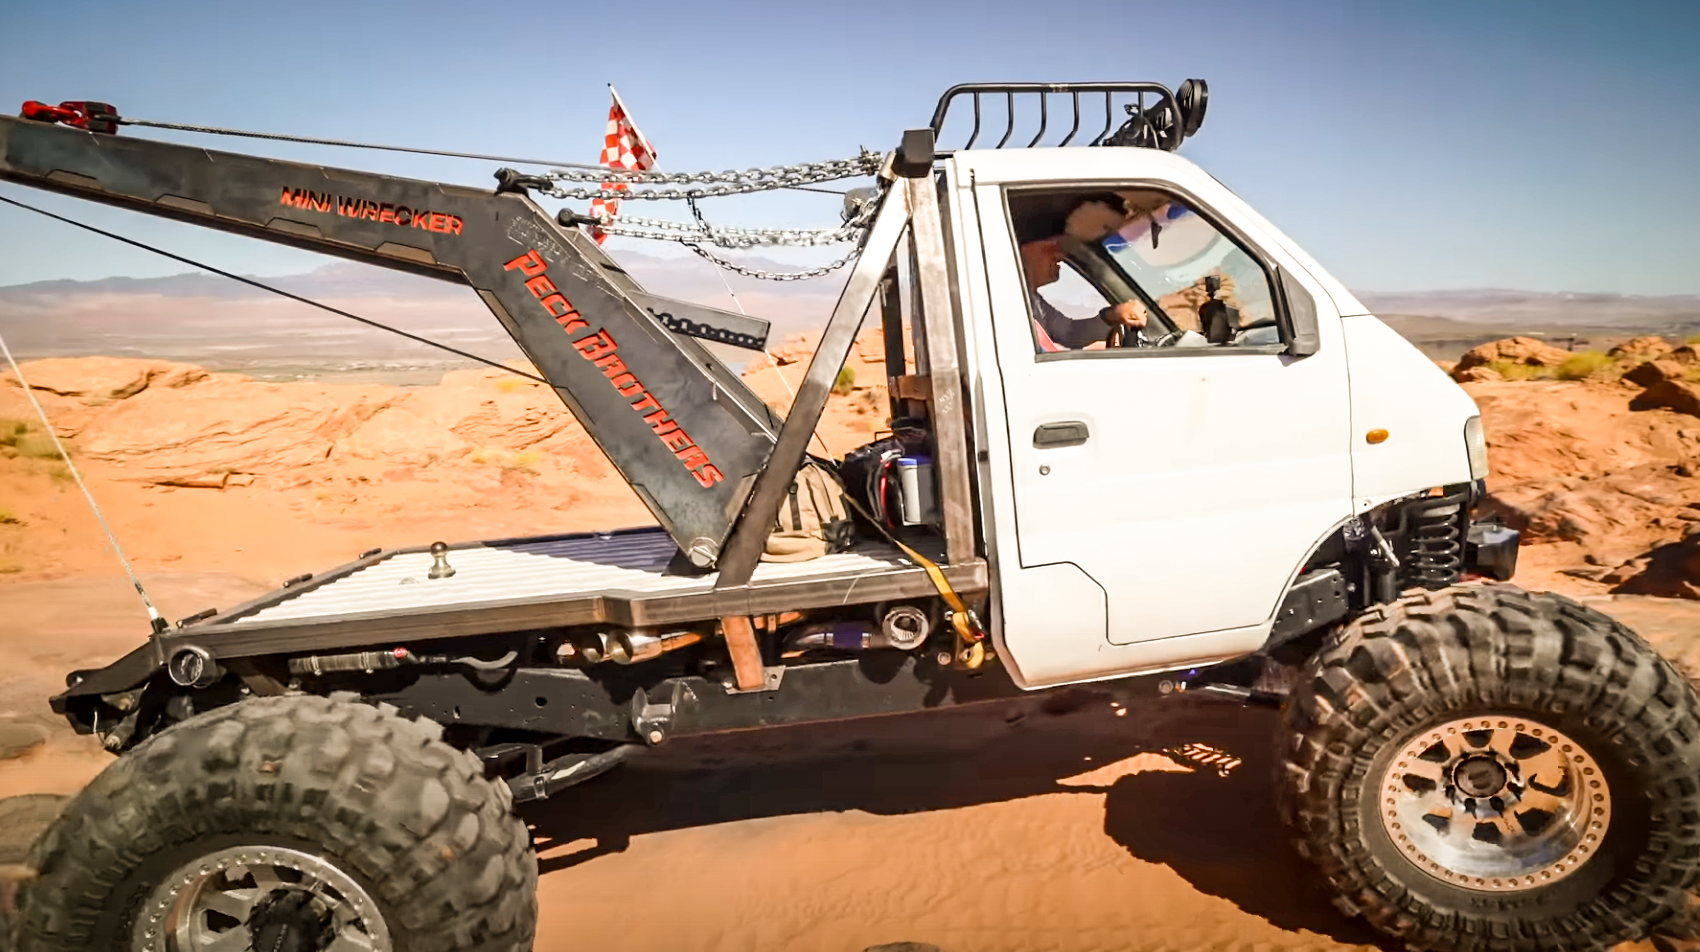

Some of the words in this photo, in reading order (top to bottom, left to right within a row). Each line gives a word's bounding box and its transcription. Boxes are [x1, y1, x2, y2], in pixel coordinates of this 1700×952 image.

[280, 186, 332, 213] MINI
[336, 195, 465, 236] WRECKER
[503, 248, 590, 335] PECK
[571, 327, 725, 489] BROTHERS
